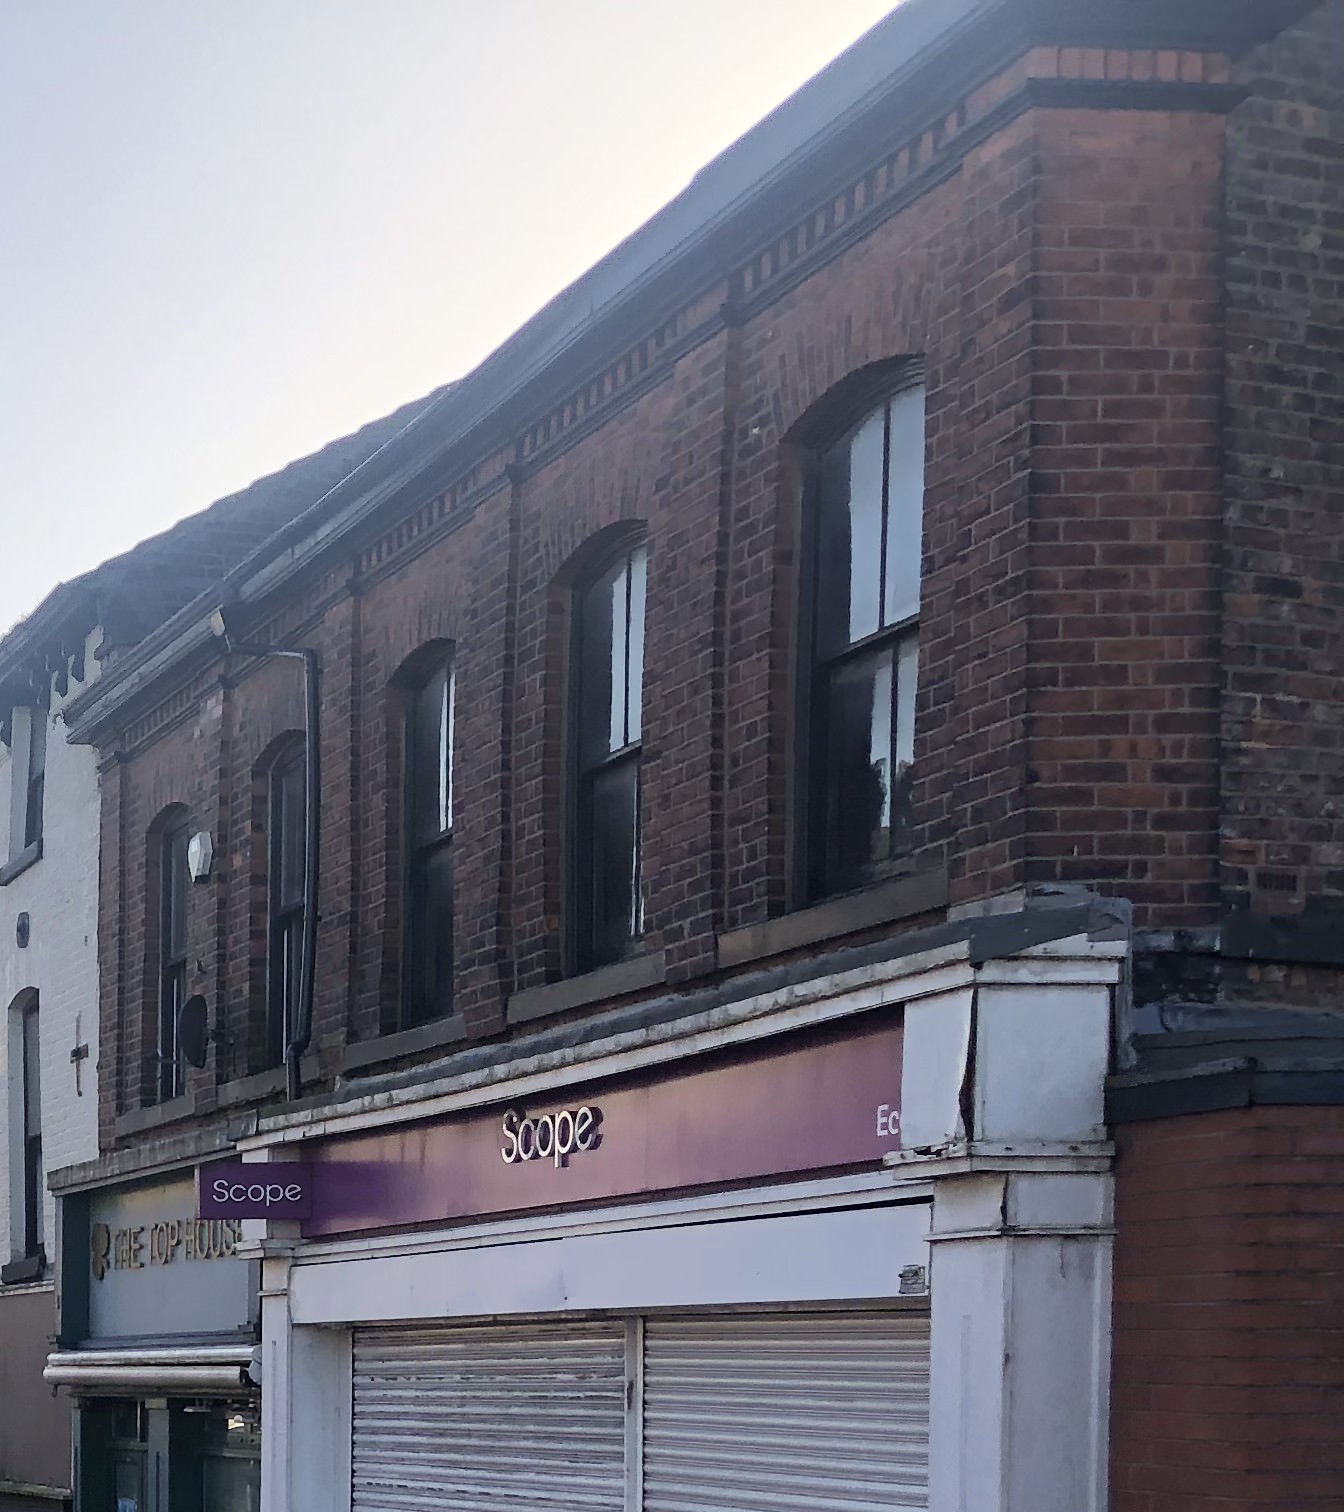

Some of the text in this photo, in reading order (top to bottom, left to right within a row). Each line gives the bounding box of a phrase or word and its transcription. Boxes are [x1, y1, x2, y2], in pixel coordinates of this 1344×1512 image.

[501, 1106, 595, 1168] Scope
[877, 1104, 900, 1136] Ec
[212, 1180, 302, 1207] Scope
[115, 1226, 144, 1269] THE
[150, 1220, 180, 1265] TOP
